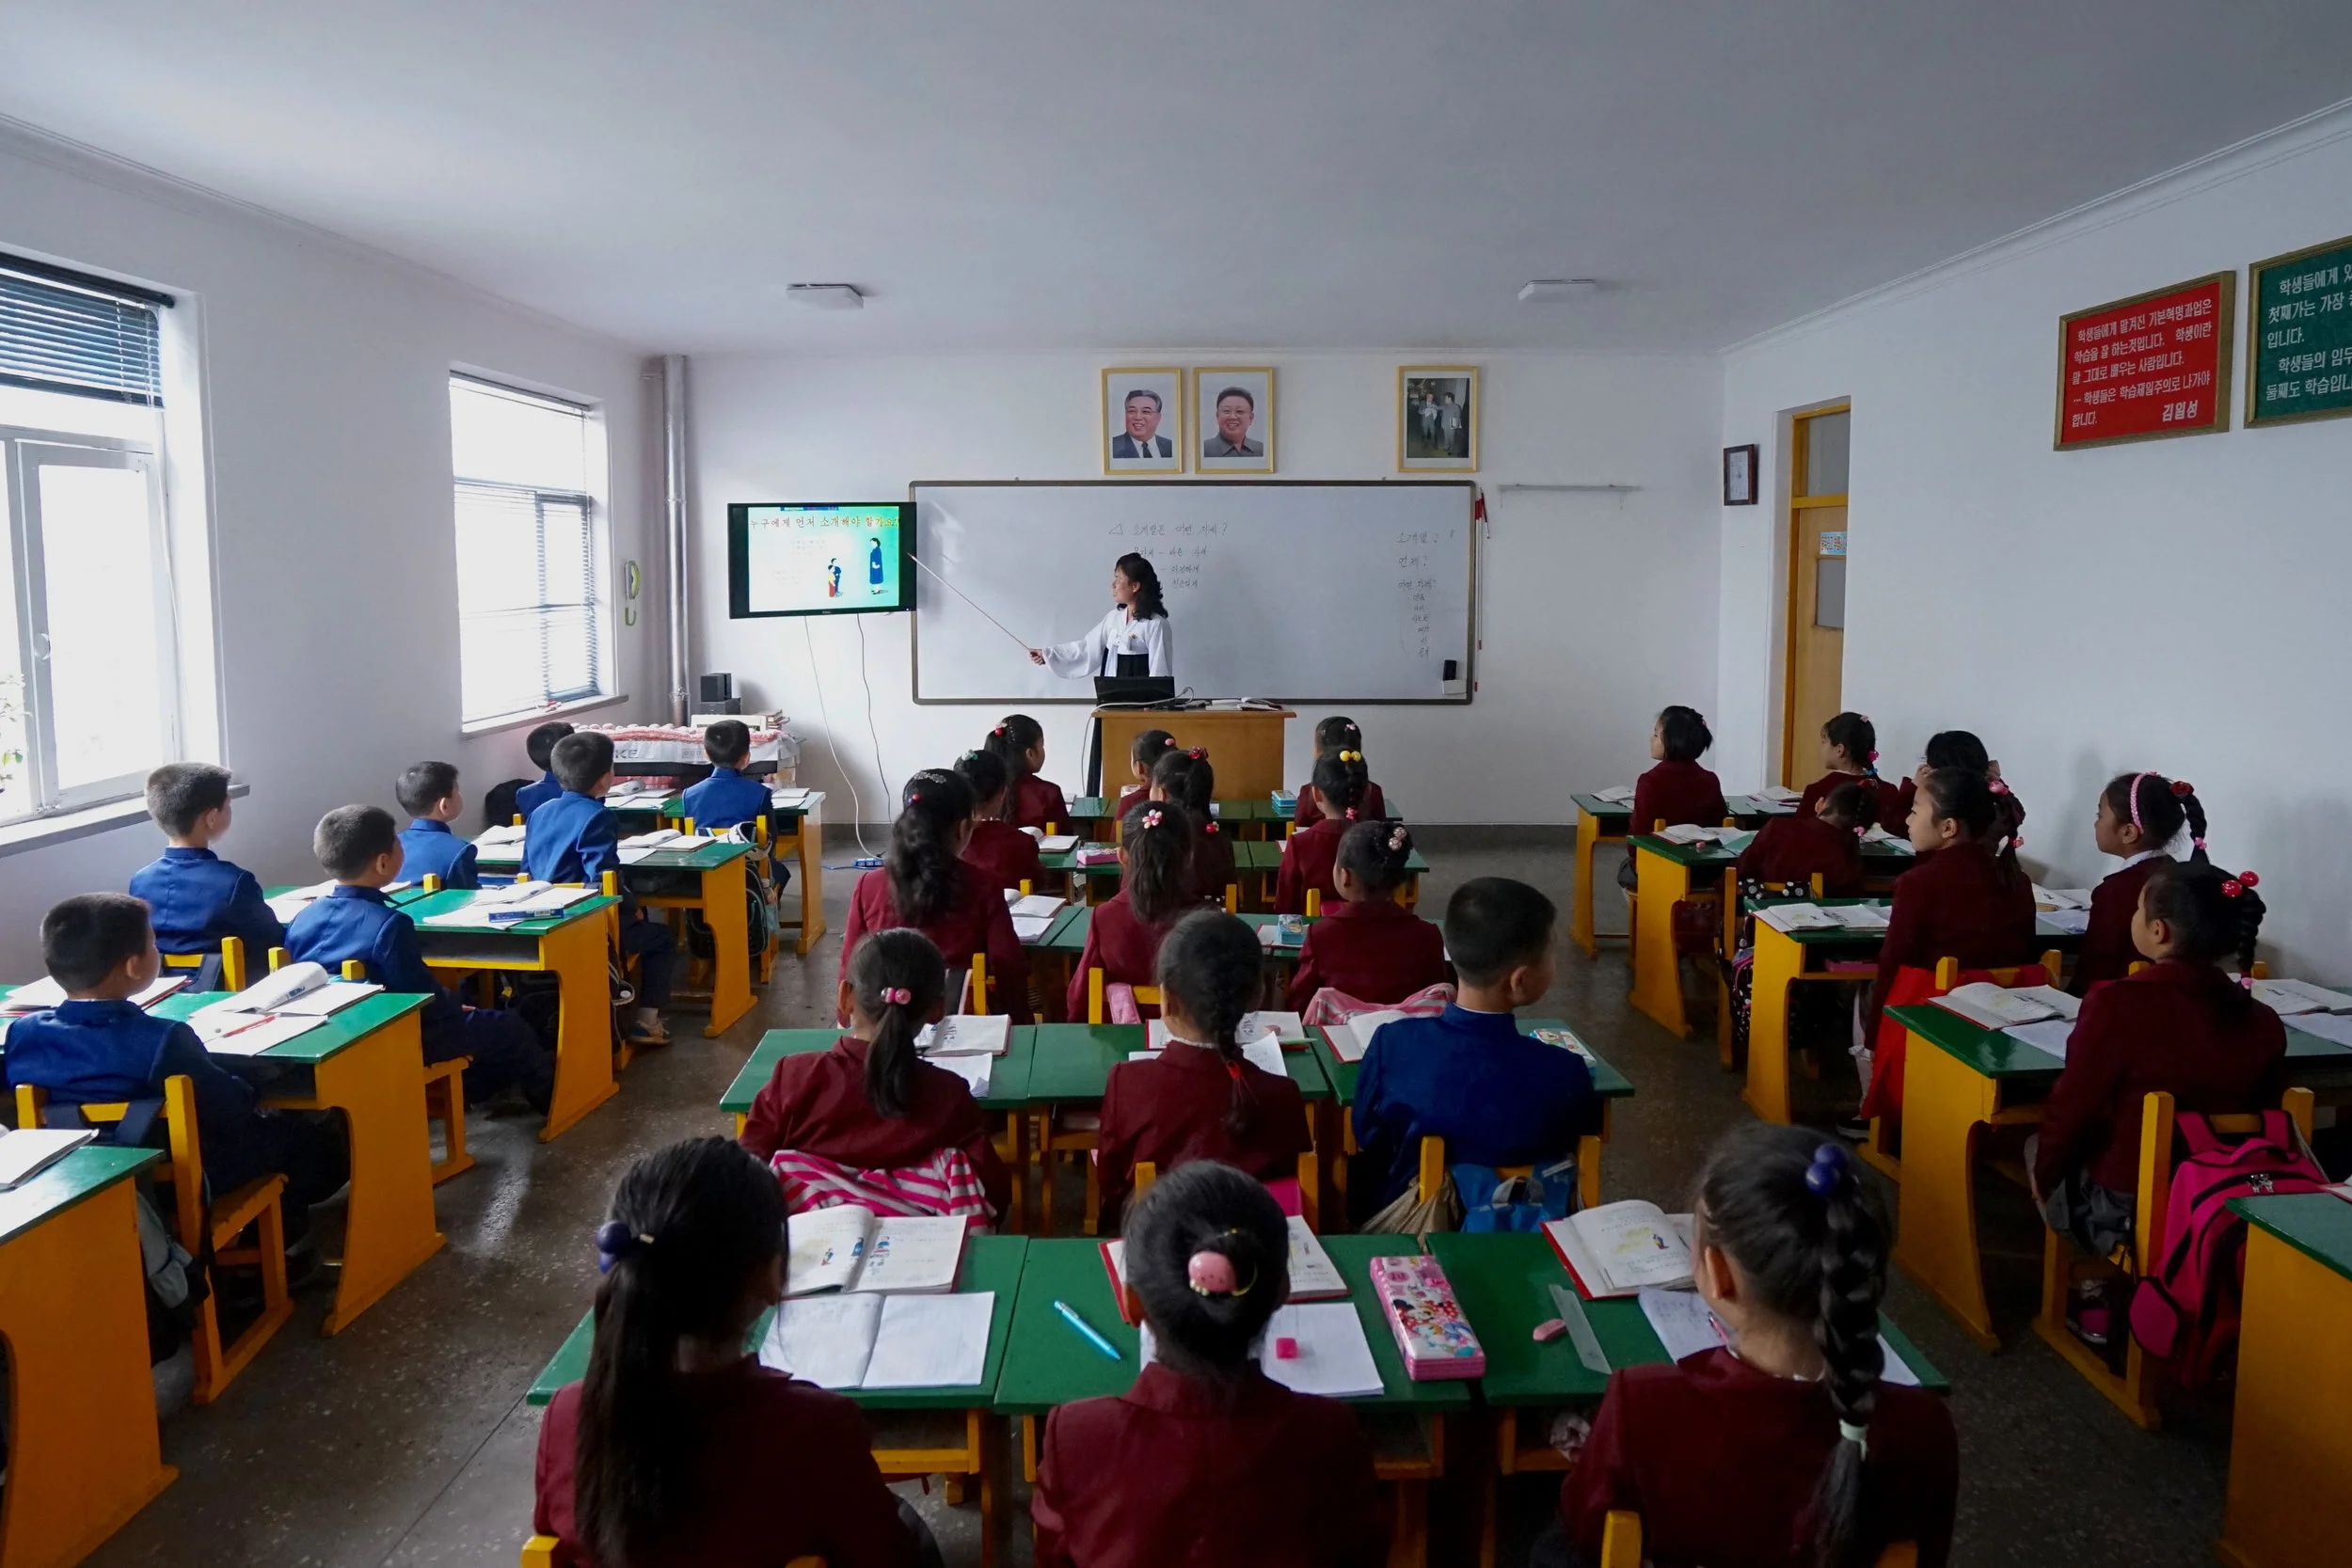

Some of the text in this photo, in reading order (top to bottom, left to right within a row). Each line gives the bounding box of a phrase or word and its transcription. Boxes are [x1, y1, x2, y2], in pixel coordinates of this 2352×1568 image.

[2280, 266, 2338, 296] 학생들에게
[2268, 300, 2315, 325] 첫째가는
[2319, 292, 2344, 312] 가장
[2074, 347, 2098, 364] 학습을
[2101, 344, 2109, 359] 잘
[2175, 321, 2213, 342] 학생이란
[2077, 322, 2117, 342] 학생들에게
[2267, 326, 2304, 349] 입니다.
[2083, 366, 2108, 384] 그대로
[2110, 361, 2137, 378] 배우는
[2138, 351, 2185, 372] 사람입니다.
[2278, 351, 2326, 374] 학생들의
[2084, 388, 2116, 405] 학생들은
[2183, 370, 2211, 388] 나가야
[2266, 380, 2300, 402] 둘째도
[2072, 400, 2199, 428] 합니다. 김일성
[751, 516, 790, 529] 누구에게
[796, 515, 815, 529] 먼저
